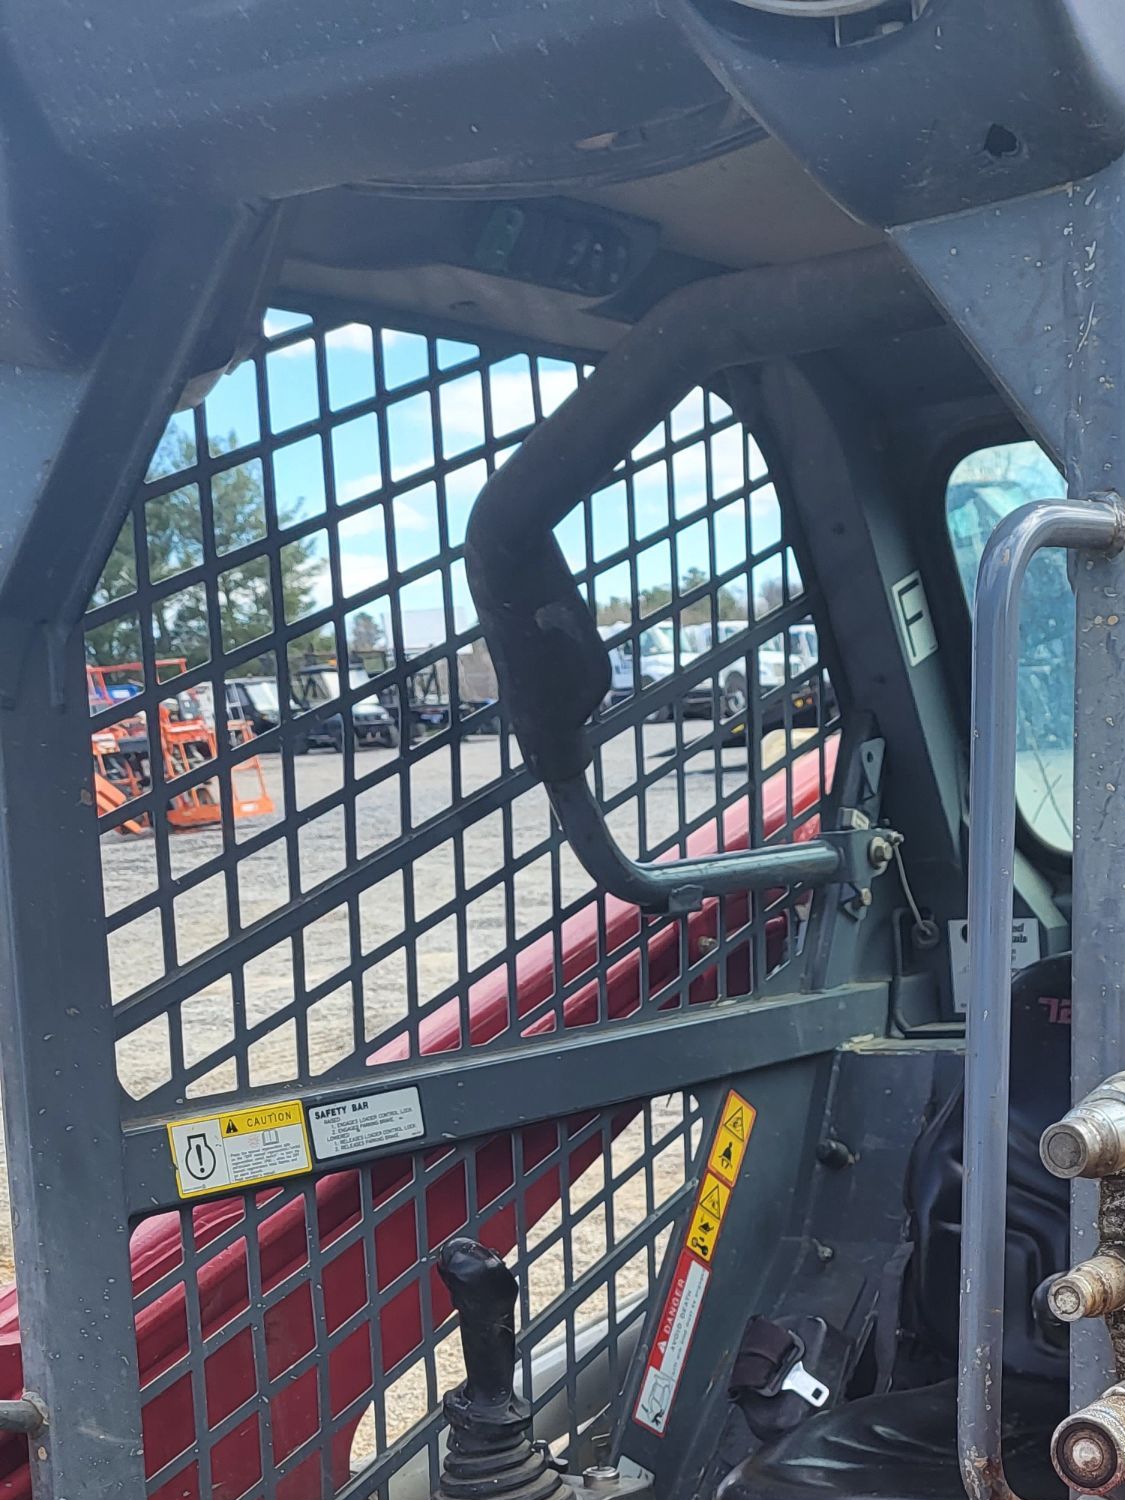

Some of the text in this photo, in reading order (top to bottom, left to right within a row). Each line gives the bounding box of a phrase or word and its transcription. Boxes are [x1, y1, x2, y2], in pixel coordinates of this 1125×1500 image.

[247, 1112, 292, 1128] CAUTION
[314, 1101, 369, 1120] SAFETY BAR
[663, 1278, 685, 1335] DANGER
